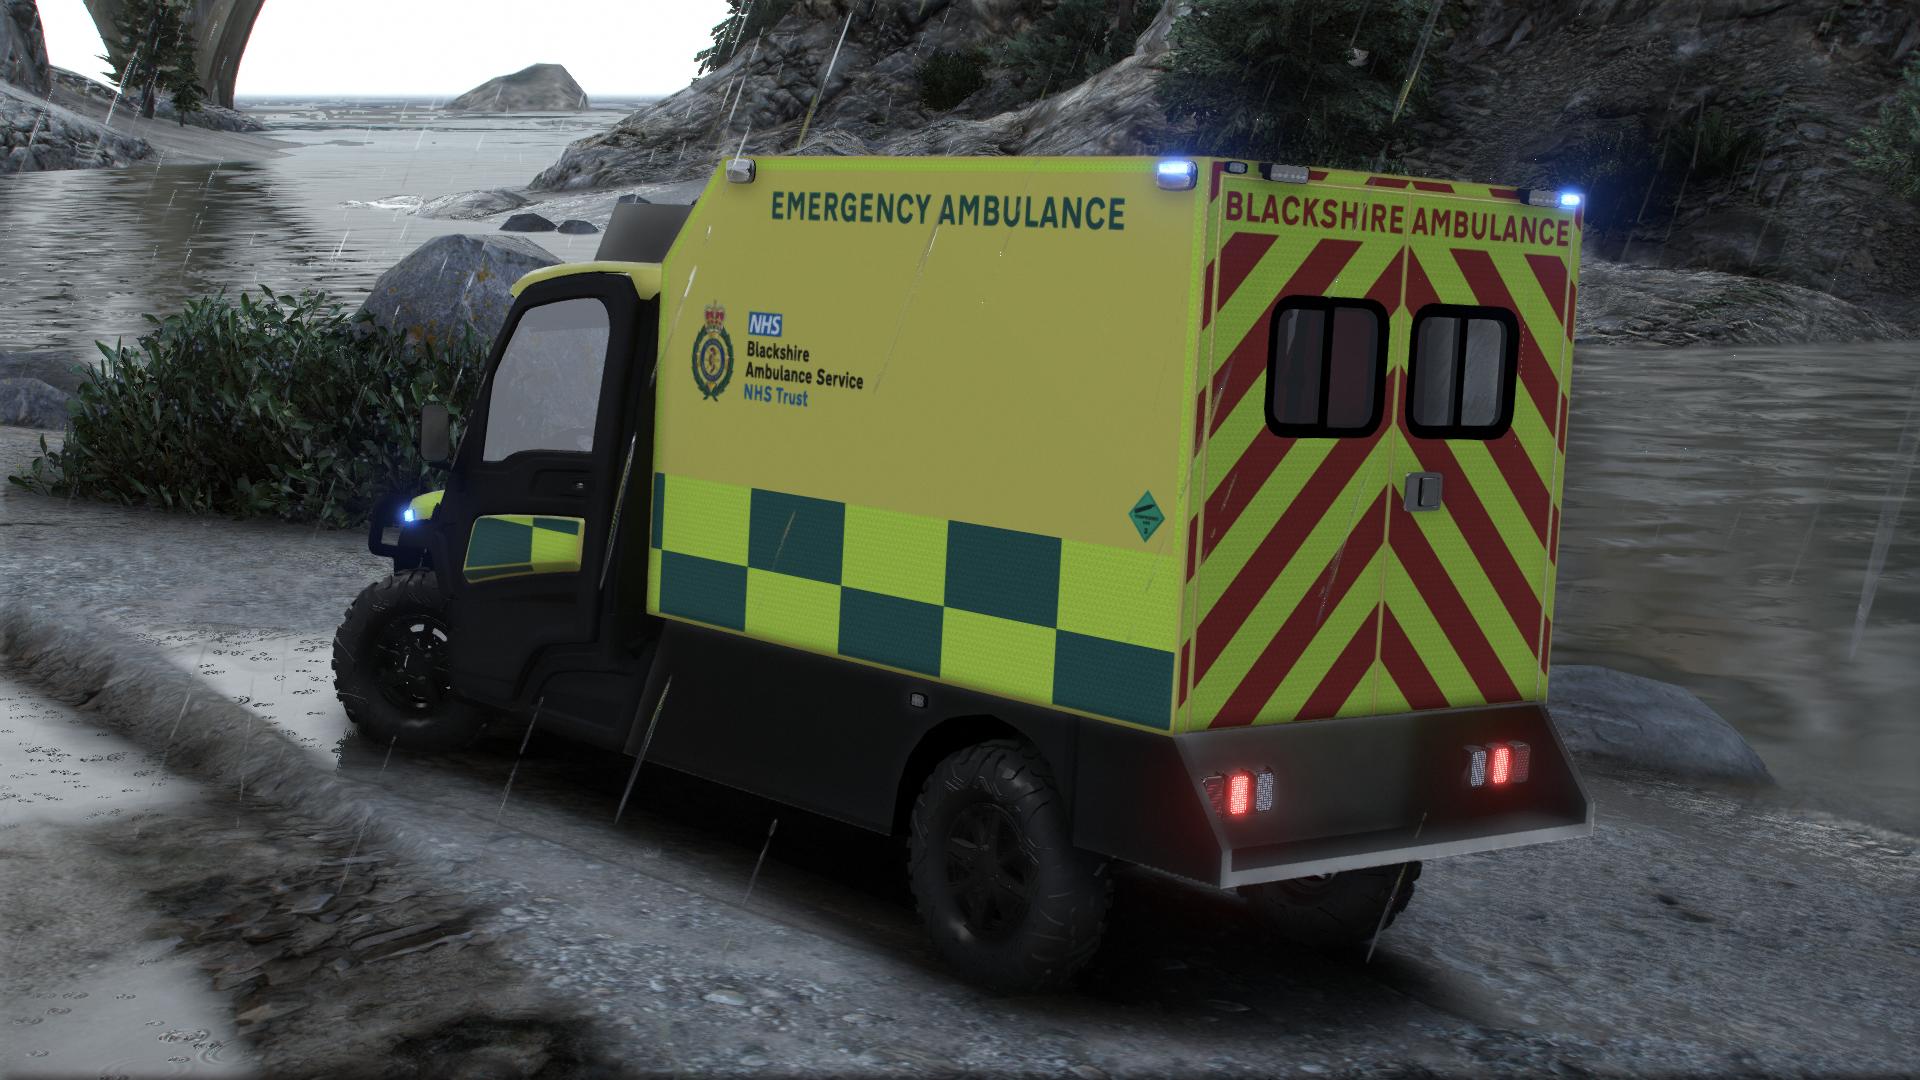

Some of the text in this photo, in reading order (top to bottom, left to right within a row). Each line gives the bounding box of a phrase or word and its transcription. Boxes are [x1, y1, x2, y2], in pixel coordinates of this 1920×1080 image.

[771, 191, 1125, 230] EMERGENCY AMBULANCE
[1225, 191, 1570, 246] BLACKSHIRE AMBULANCE
[749, 314, 782, 335] NHS
[747, 341, 810, 362] Blackshire
[745, 362, 864, 389] Ambulance Service
[743, 385, 808, 407] NHS Trust
